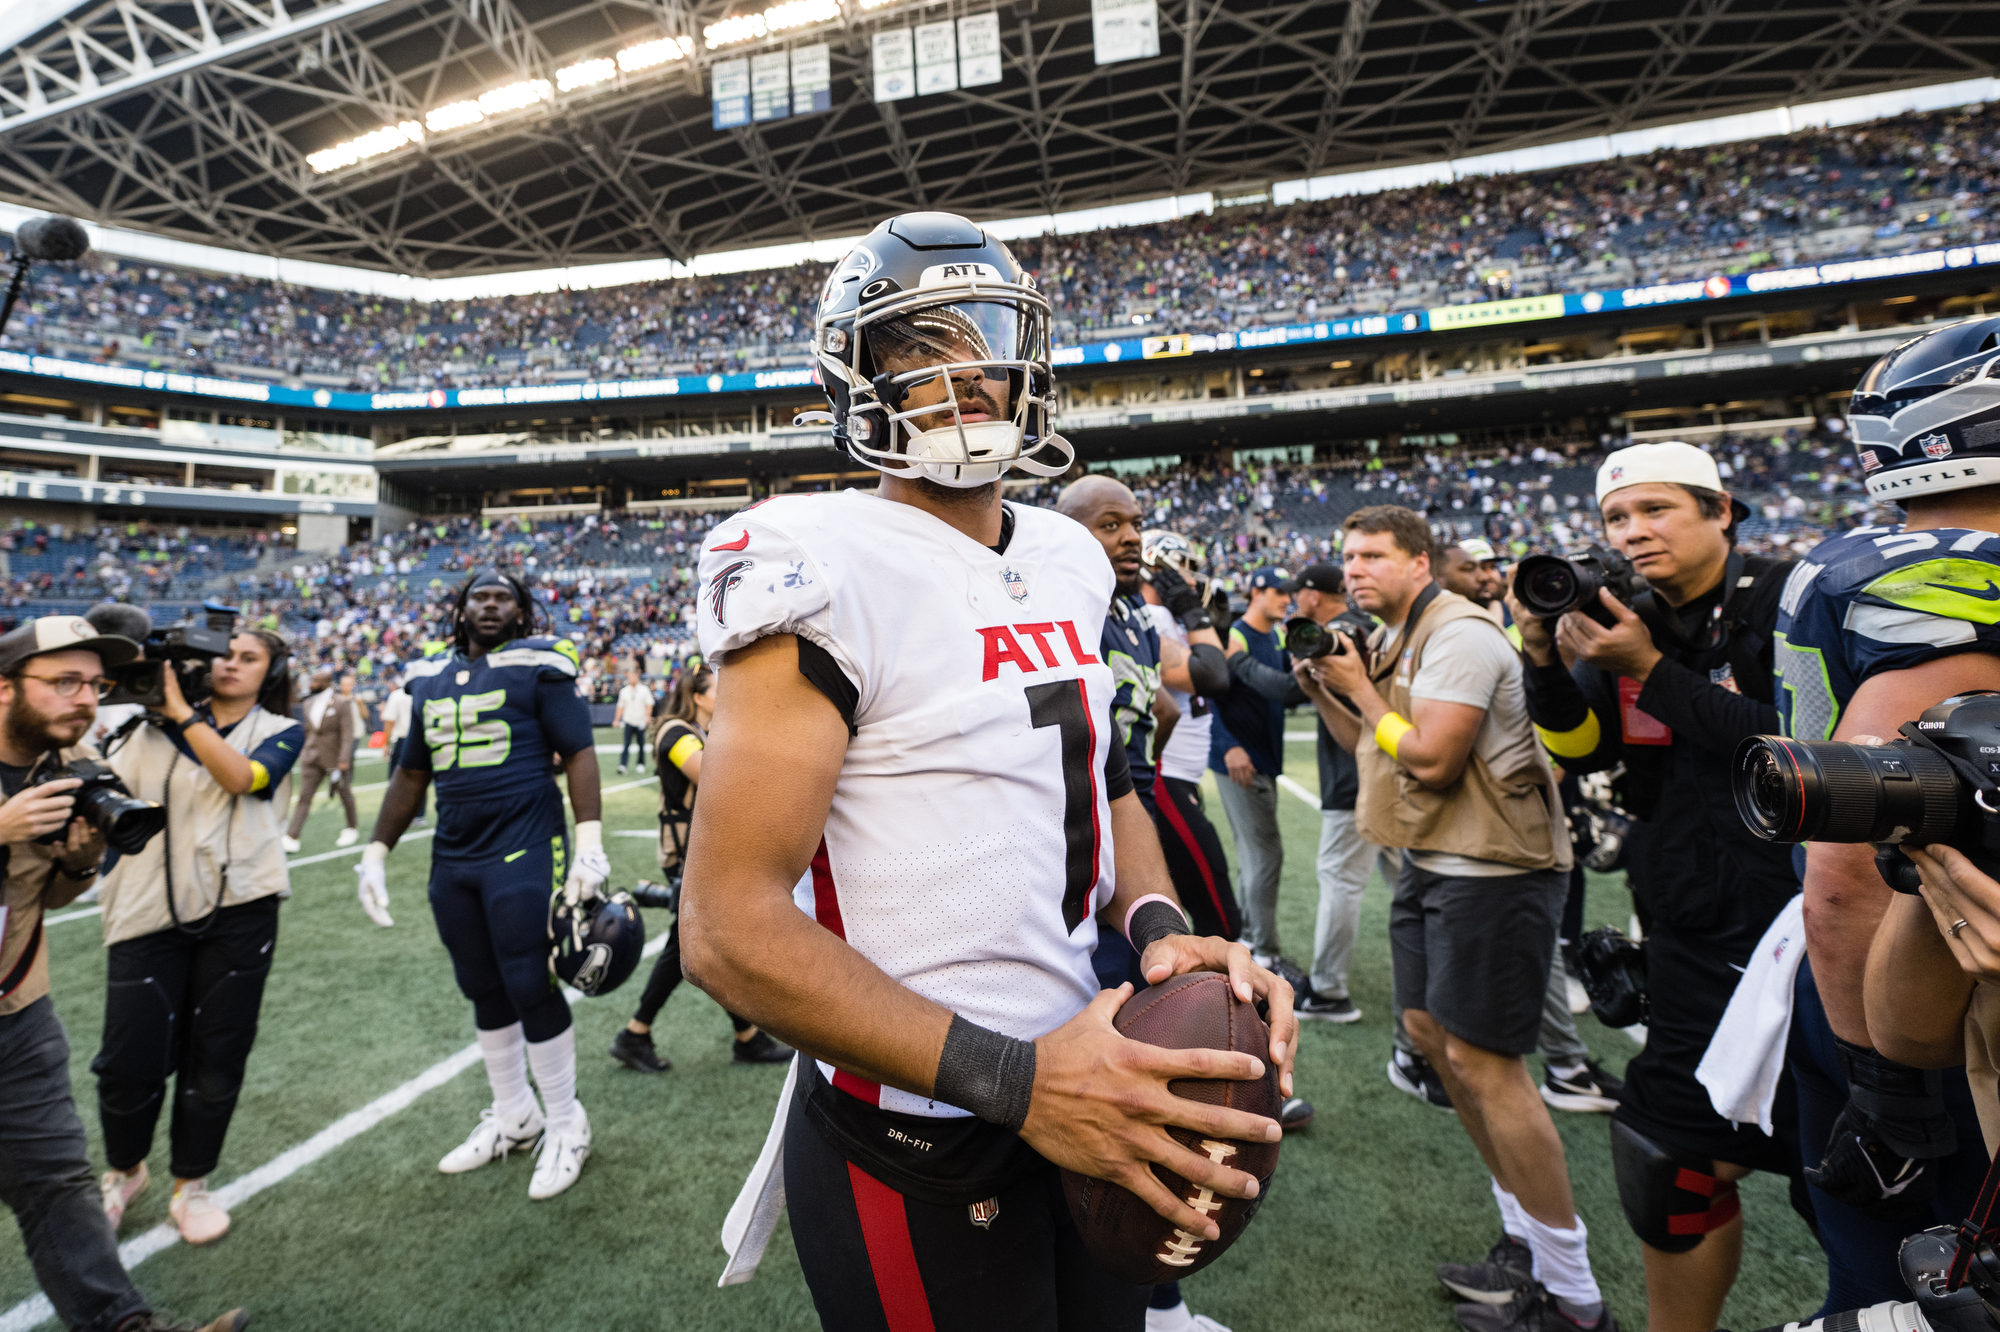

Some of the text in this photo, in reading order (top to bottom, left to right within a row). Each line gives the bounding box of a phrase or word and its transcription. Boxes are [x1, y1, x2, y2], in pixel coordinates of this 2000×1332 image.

[943, 264, 986, 278] ATL
[1746, 242, 2000, 292] OFFICIAL SUPERMARKET OF TH
[1622, 280, 1705, 307] SAFEWAY
[1447, 304, 1546, 321] SEAHAWKS
[31, 355, 144, 387] SUPERMARKET
[143, 370, 166, 389] OF
[166, 373, 195, 393] THE
[195, 376, 270, 401] SEAHAWKS
[754, 368, 813, 388] SAFEWAY
[371, 392, 429, 409] SAFEWAY
[457, 378, 679, 406] OFFICIAL SUPERMARKET OF THE SEAHAWKS
[975, 620, 1100, 682] ATL
[423, 689, 511, 772] 95
[1918, 720, 1946, 734] Canon
[1023, 677, 1101, 938] 1
[887, 1128, 933, 1152] DRI-FIT
